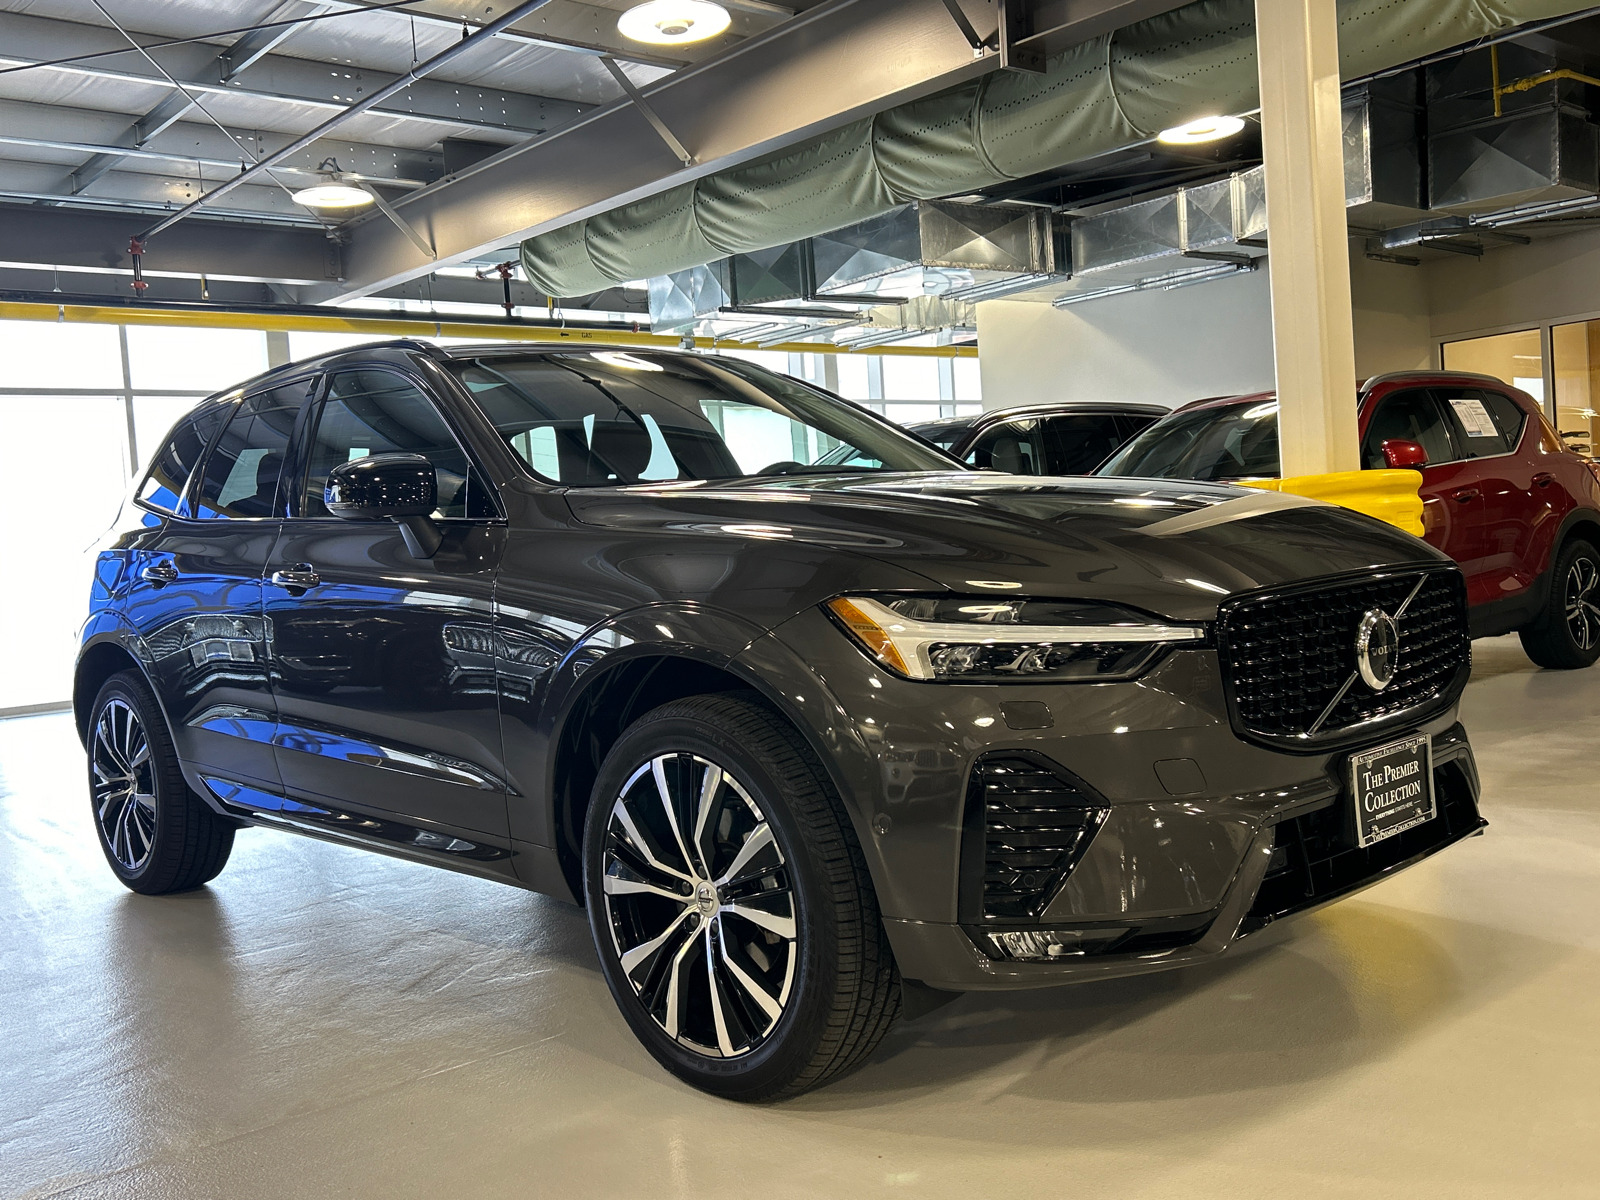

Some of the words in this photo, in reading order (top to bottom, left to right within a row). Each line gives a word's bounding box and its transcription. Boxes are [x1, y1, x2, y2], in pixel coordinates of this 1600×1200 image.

[1363, 771, 1383, 791] THE
[1384, 760, 1420, 784] PREMIER
[1364, 780, 1420, 813] COLLECTION
